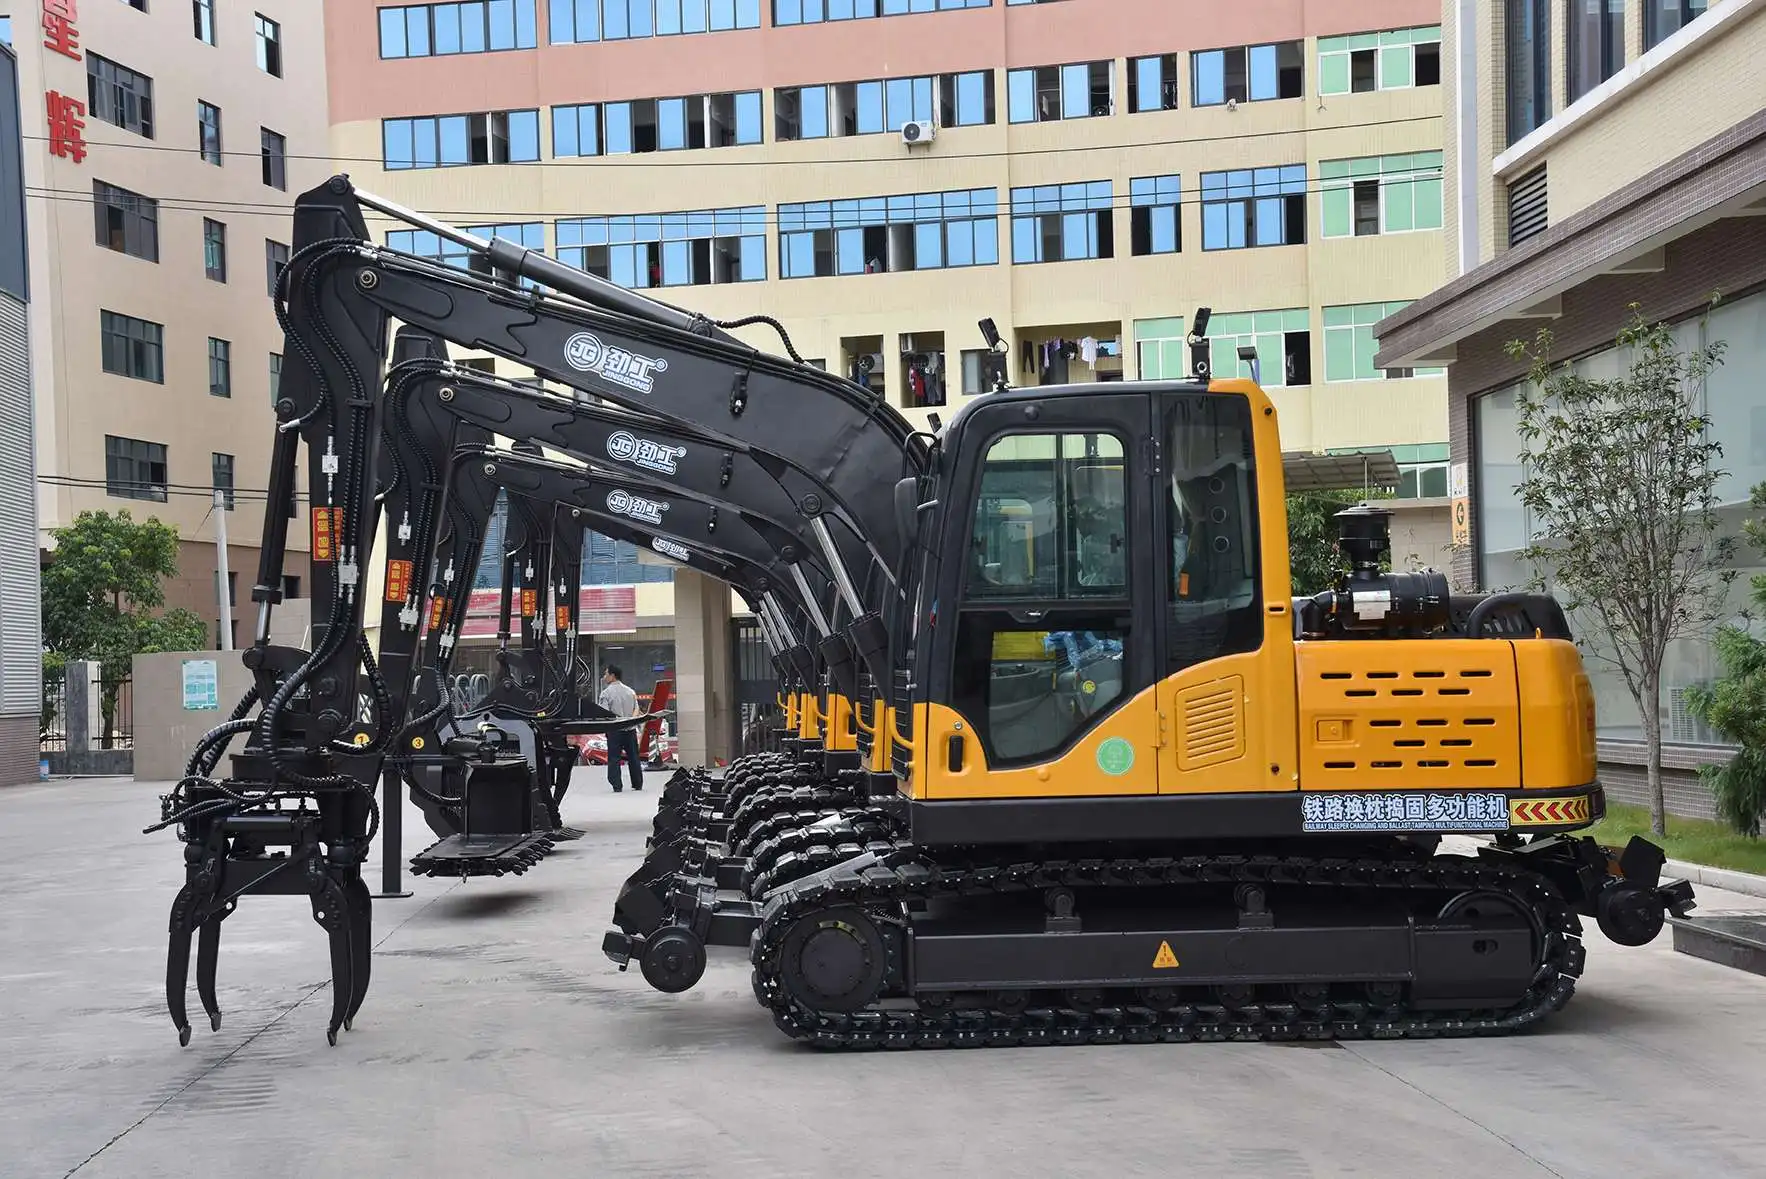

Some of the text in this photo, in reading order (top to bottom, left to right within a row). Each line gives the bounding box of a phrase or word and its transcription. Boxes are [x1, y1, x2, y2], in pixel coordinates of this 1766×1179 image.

[604, 346, 656, 383] 劲工
[638, 441, 677, 466] 劲工
[631, 498, 662, 517] 劲工
[1328, 822, 1350, 830] SLEEPER
[1377, 822, 1388, 830] AND
